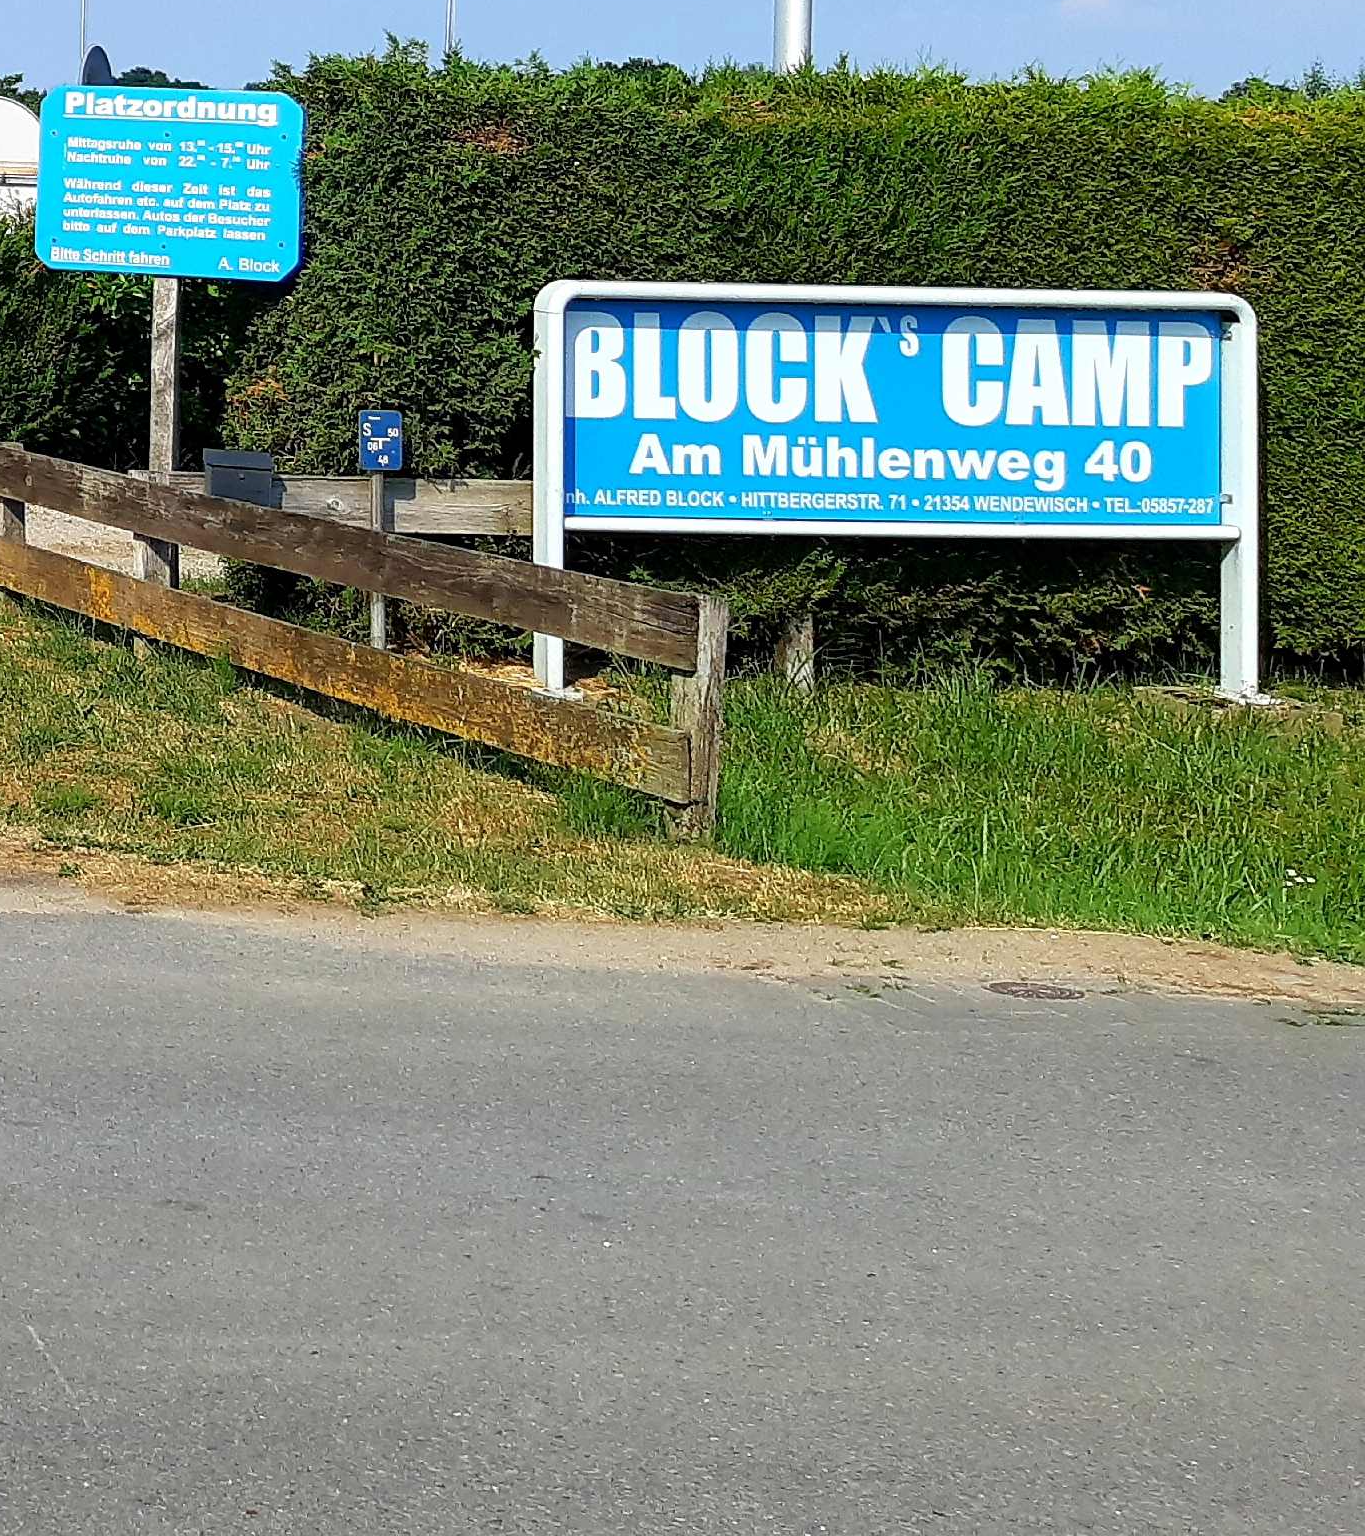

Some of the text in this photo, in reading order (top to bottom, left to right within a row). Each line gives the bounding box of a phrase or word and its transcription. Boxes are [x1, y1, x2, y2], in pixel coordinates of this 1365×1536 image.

[65, 91, 278, 126] Platzordnung
[67, 137, 141, 152] Mittagsruhe
[148, 141, 172, 152] von
[247, 144, 271, 155] Uhr
[67, 152, 131, 165] Nachtruhe
[143, 156, 167, 166] von
[247, 159, 270, 170] Uhr
[63, 178, 271, 198] Während dieser Zeit ist das
[63, 192, 270, 212] Autofahren etc. auf dem Platz zu
[63, 208, 270, 226] unterlassen. Autos der Besucher
[63, 221, 266, 241] bitte auf dem Parkplatz lassen
[51, 246, 170, 266] Bitte Schritt fahren
[218, 258, 280, 273] A. Block
[941, 315, 1214, 427] CAMP
[363, 423, 371, 436] S
[629, 434, 1153, 492] Am Mühlenweg 40
[567, 488, 591, 506] nh.
[594, 489, 662, 508] ALFRED
[666, 490, 725, 509] BLOCK
[741, 491, 884, 511] HITTBERGERSTR.
[888, 495, 907, 511] 71
[923, 495, 970, 512] 21354
[973, 496, 1088, 514] WENDEWISCH
